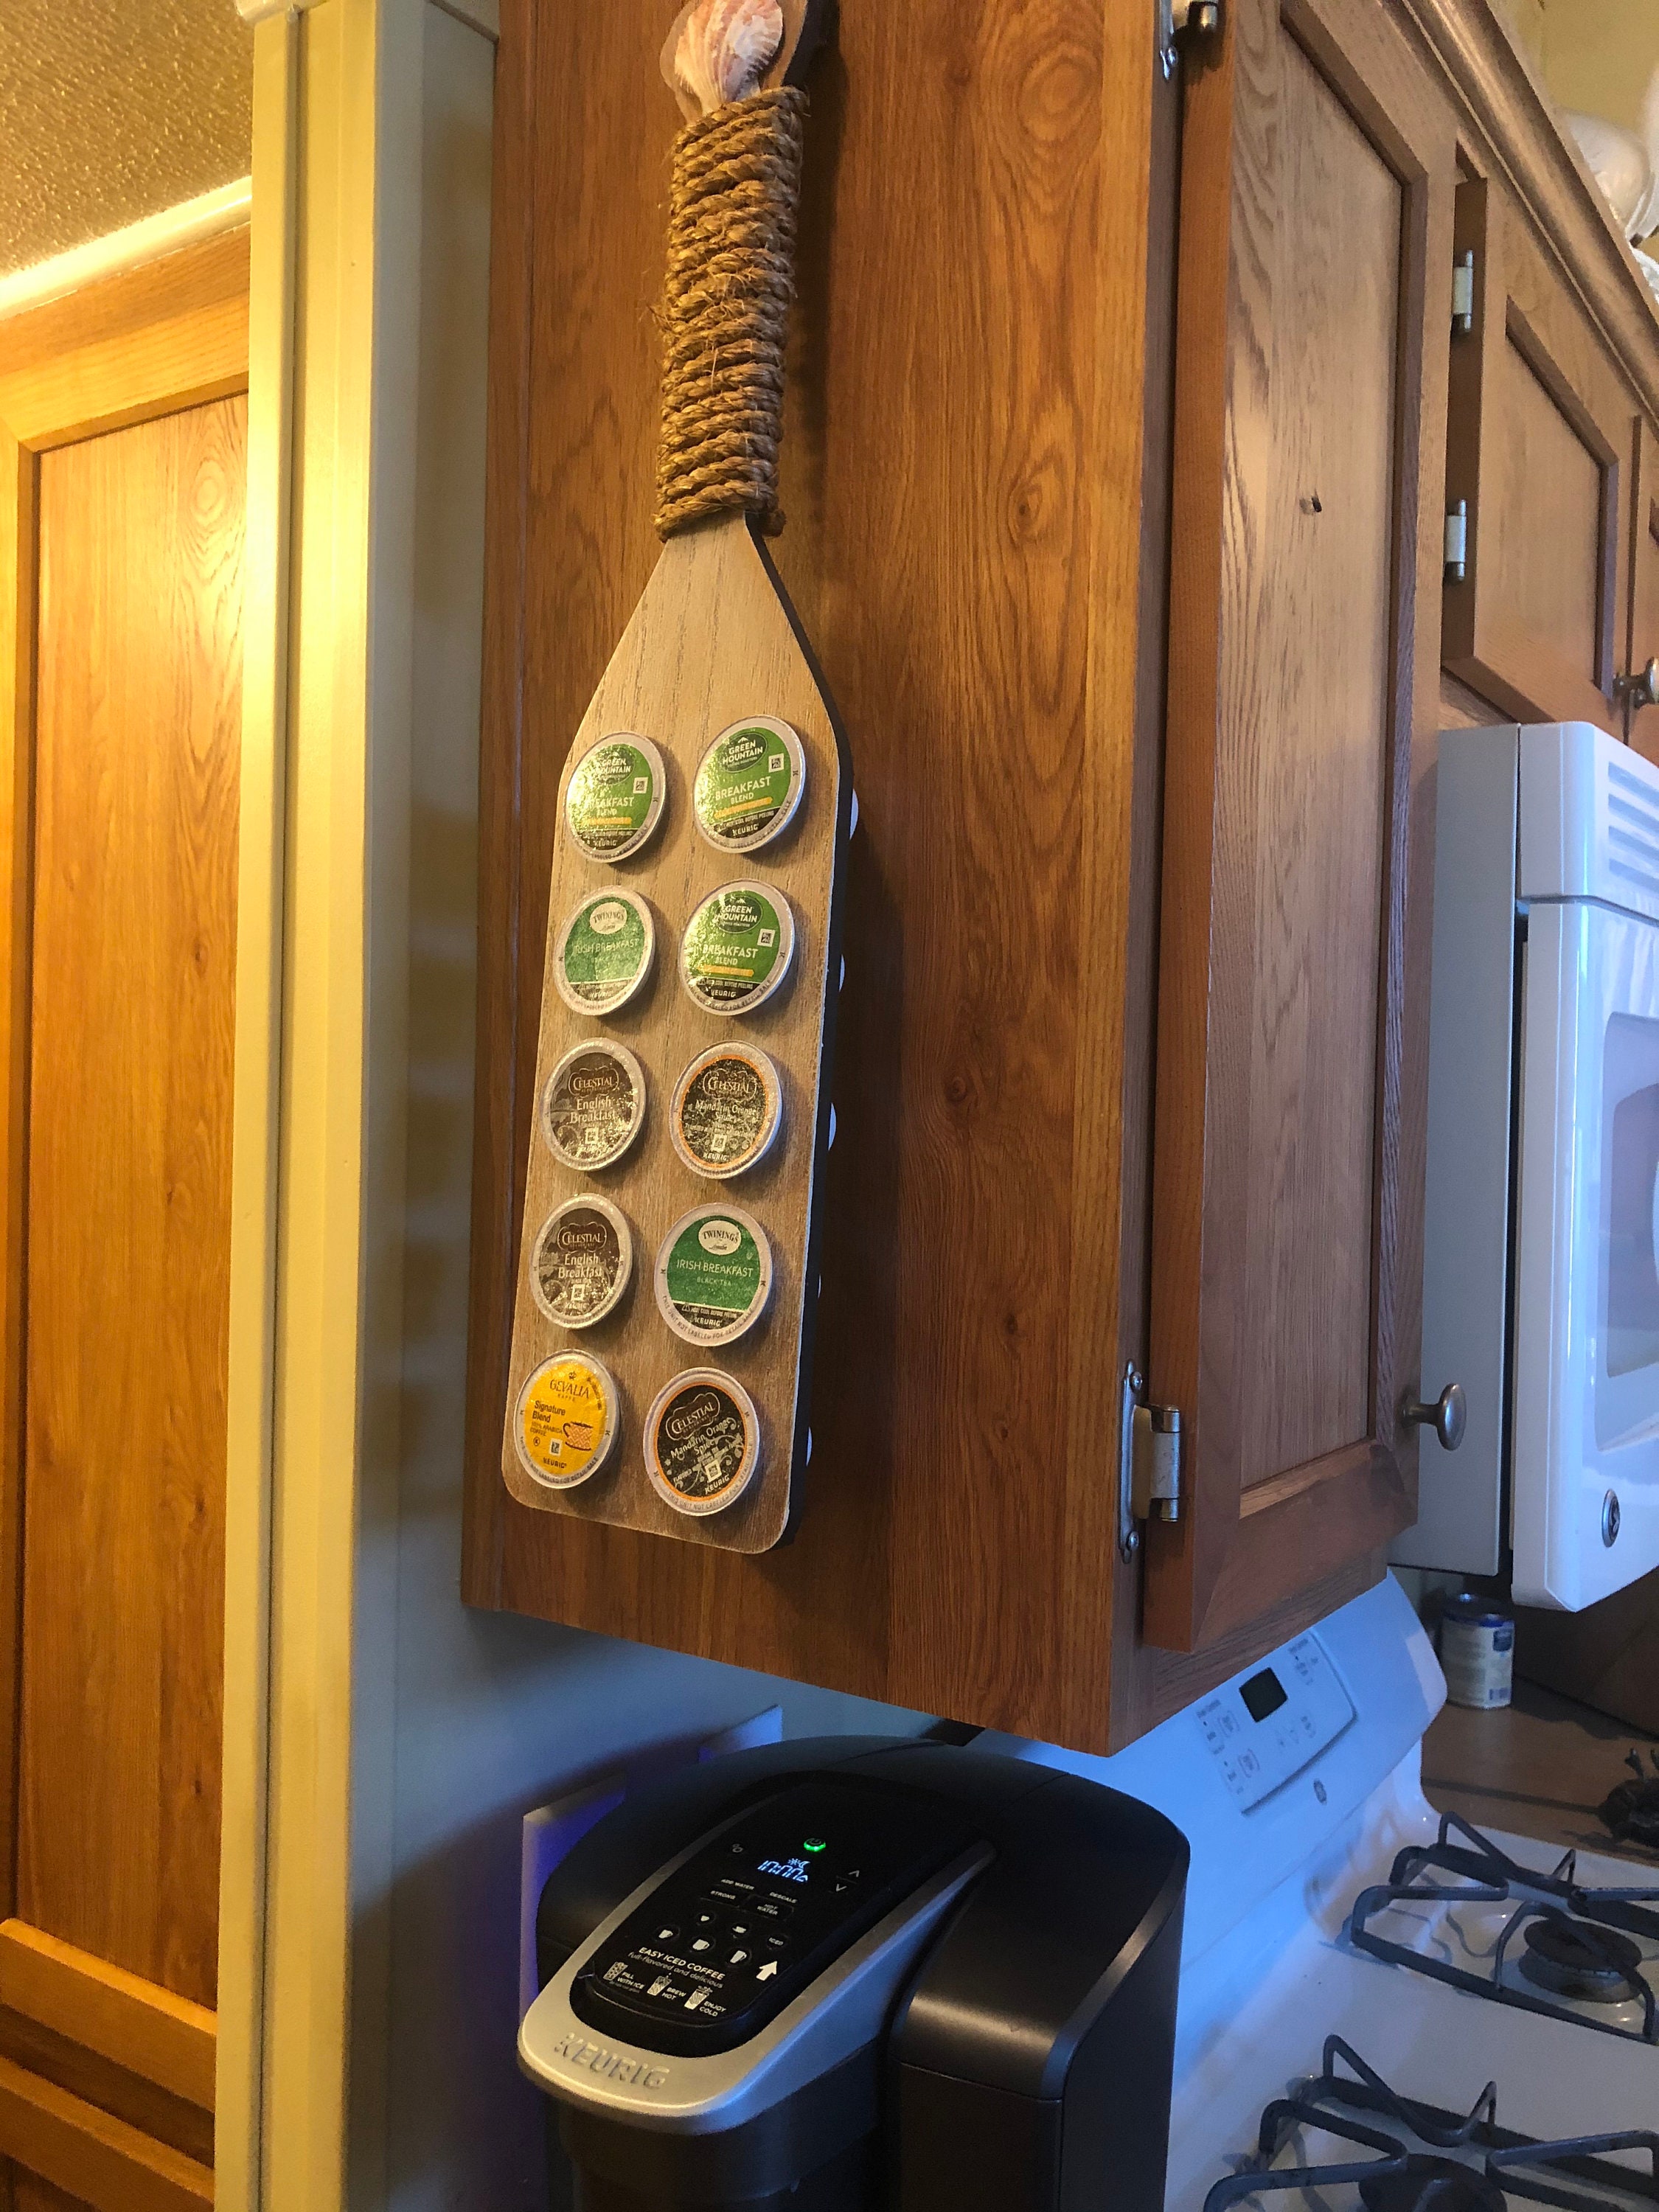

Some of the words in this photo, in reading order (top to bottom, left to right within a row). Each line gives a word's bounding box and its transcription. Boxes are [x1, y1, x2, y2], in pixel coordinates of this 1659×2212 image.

[728, 740, 756, 755] GREEN
[723, 747, 763, 764] MOUNTAIN
[714, 776, 771, 801] BREAKFAST
[731, 793, 754, 804] BLEND
[732, 824, 759, 835] KEURIG
[726, 905, 753, 914] GREEN
[593, 911, 625, 923] TWININGS
[572, 944, 594, 955] IRISH
[595, 939, 639, 953] BREAKFAST
[703, 945, 759, 959] BREAKFAST
[715, 957, 738, 966] BLEND
[573, 1077, 613, 1089] CELESTIAL
[577, 1096, 612, 1111] English
[570, 1110, 618, 1124] Breakfast
[703, 1152, 727, 1161] KEURIG
[562, 1231, 602, 1245] CELESTIAL
[703, 1230, 740, 1243] TWININGS
[565, 1253, 599, 1267] English
[558, 1267, 603, 1279] Breakfast
[676, 1259, 701, 1270] IRISH
[703, 1262, 754, 1278] BREAKFAST
[697, 1277, 717, 1285] BLACK
[695, 1317, 721, 1326] KEURIG
[549, 1379, 590, 1399] GEVALIA
[535, 1400, 566, 1416] Signature
[532, 1411, 552, 1423] Blend
[672, 1402, 715, 1434] CELESTIAL
[670, 1434, 706, 1458] Mandarin
[706, 1418, 731, 1436] Orange
[543, 1457, 566, 1469] KEURIG
[704, 1474, 730, 1495] KEURIG
[734, 1882, 754, 1891] WATER
[710, 1890, 736, 1900] STRONG
[769, 1891, 798, 1904] DESCALE
[757, 1905, 778, 1916] WATER
[768, 1937, 784, 1946] ICED
[639, 1947, 664, 1958] EASY
[664, 1955, 686, 1966] ICED
[687, 1963, 726, 1980] COFFEE
[622, 1972, 634, 1980] FILL
[628, 1952, 675, 1971] full-flavored
[674, 1966, 688, 1976] and
[689, 1971, 724, 1989] delicious
[617, 1977, 634, 1986] WITH
[662, 1992, 676, 2000] HOT
[667, 1987, 686, 1997] BREW
[700, 2006, 718, 2017] COLD
[703, 2000, 727, 2012] ENJOY
[554, 2032, 670, 2090] KEURIG
